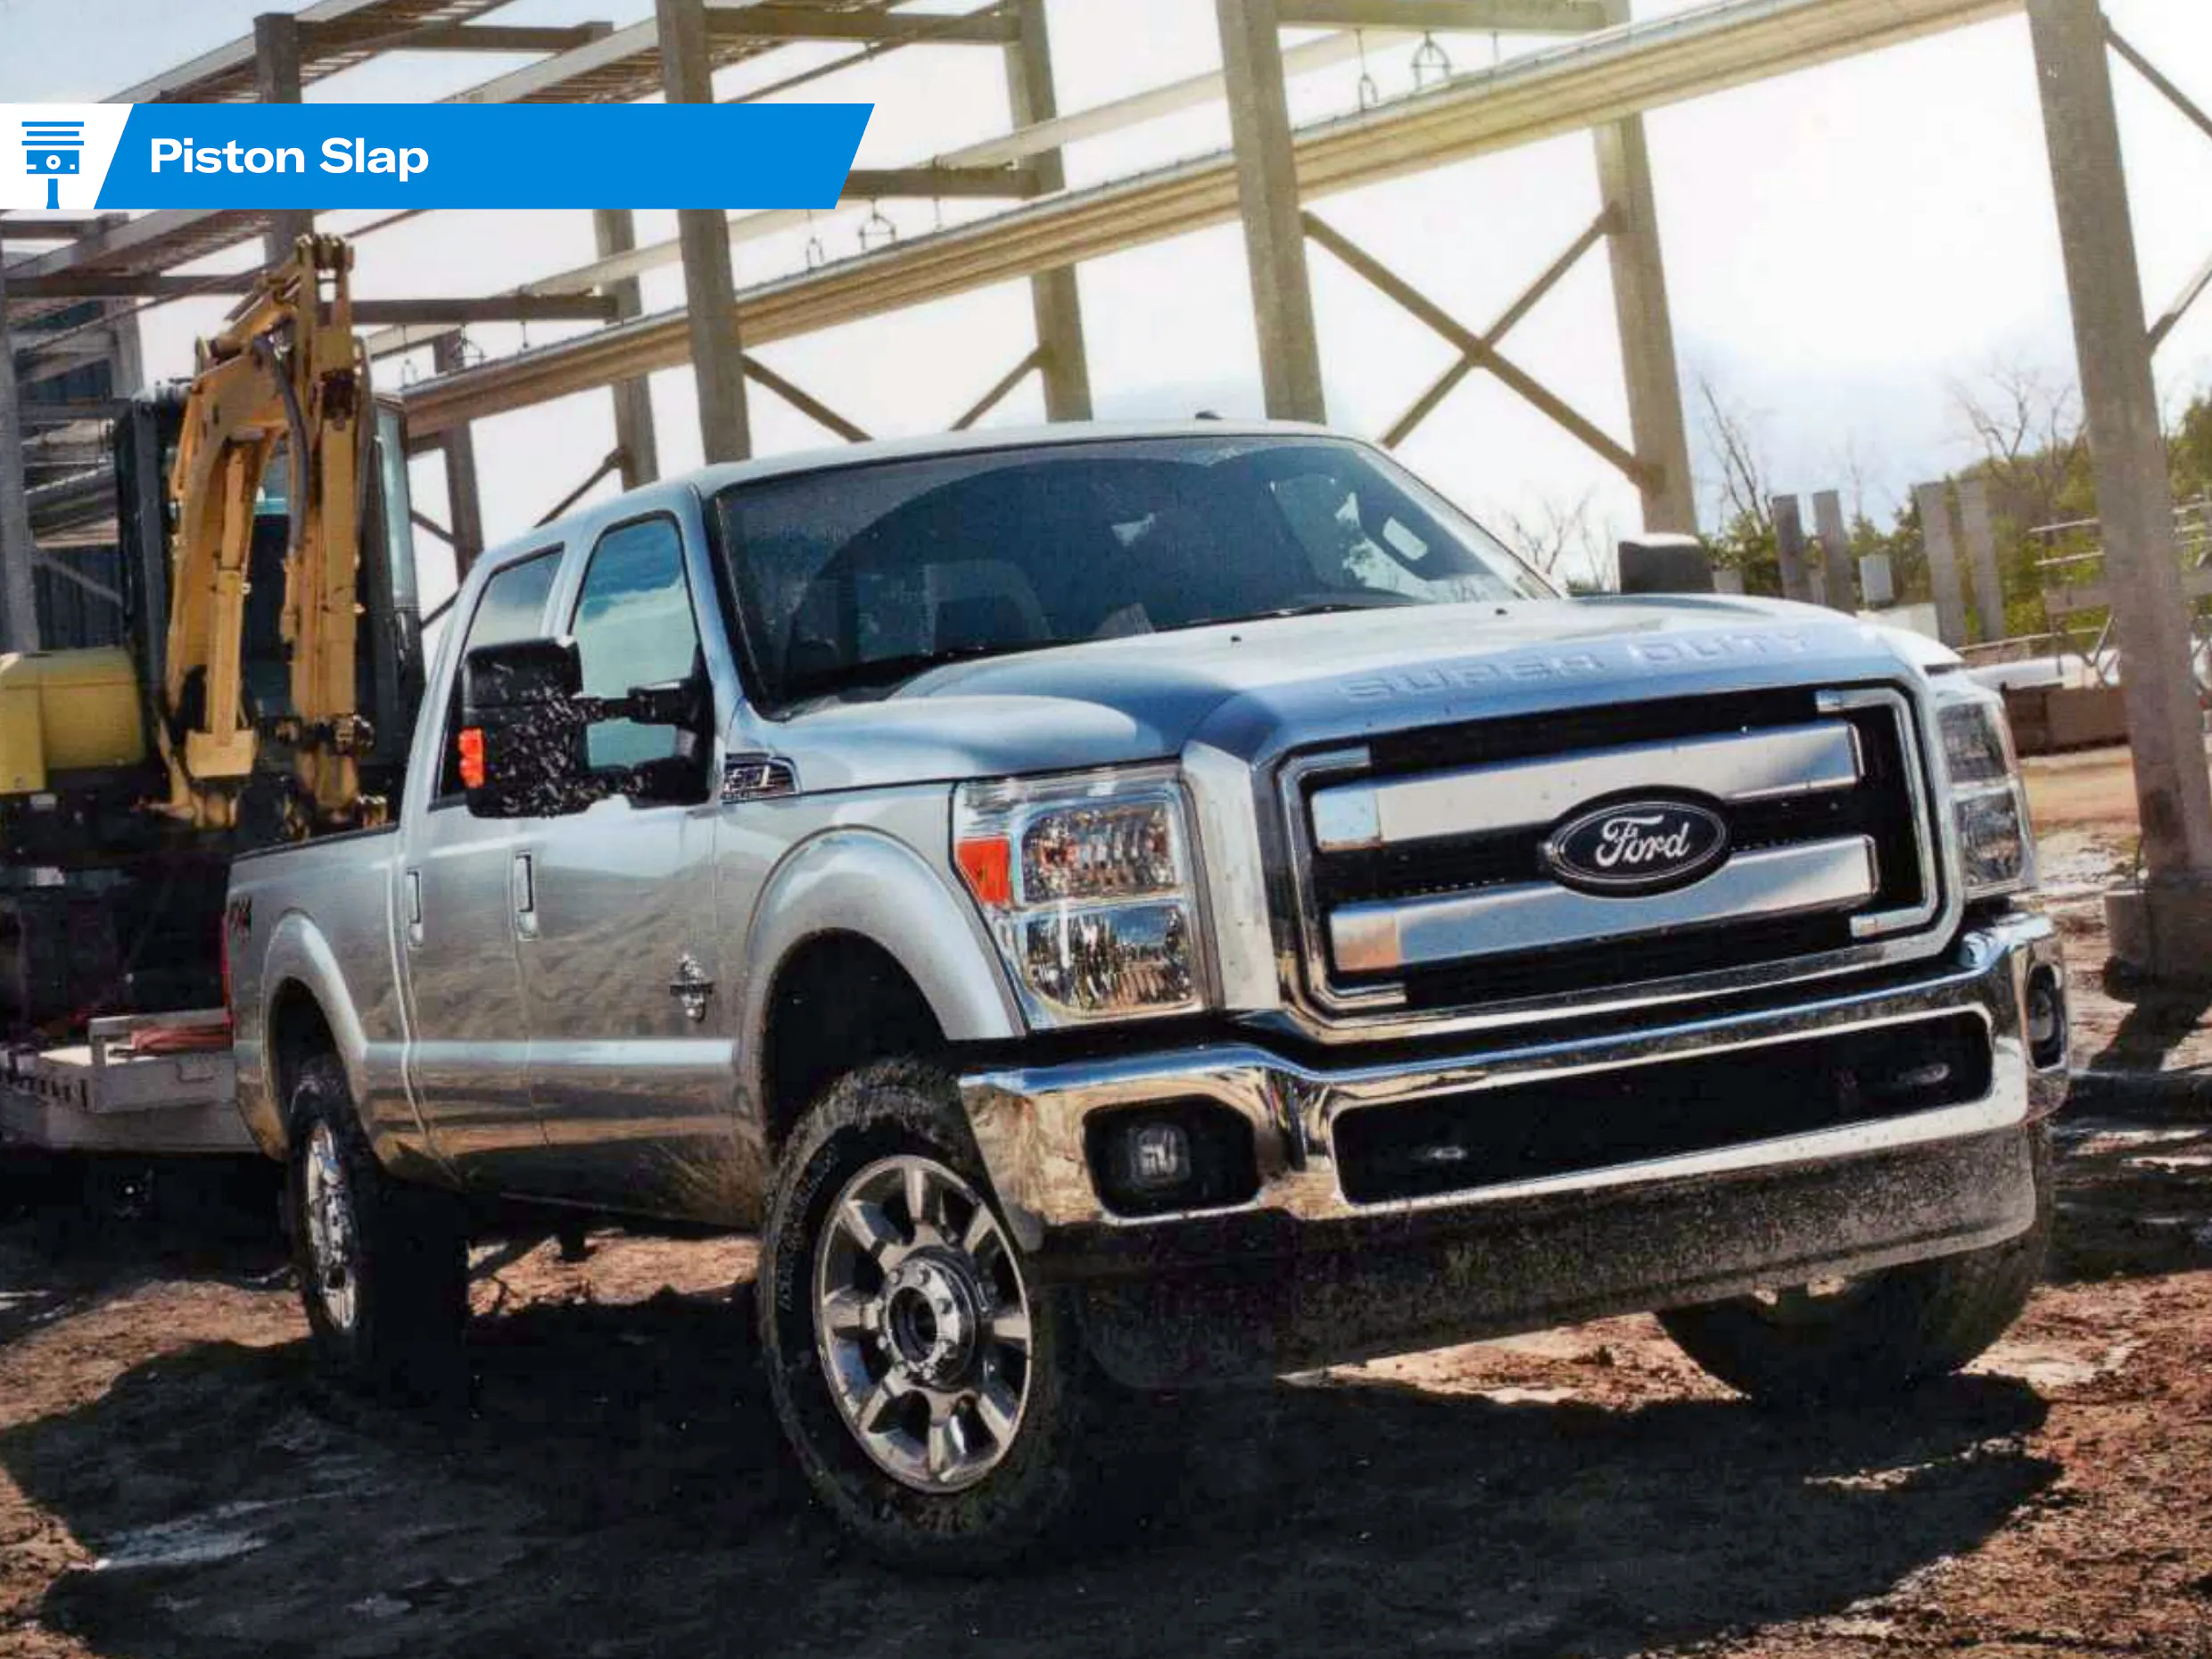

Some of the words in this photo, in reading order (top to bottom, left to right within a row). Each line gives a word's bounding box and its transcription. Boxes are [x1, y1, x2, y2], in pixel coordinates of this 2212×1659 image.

[1341, 655, 1604, 701] SUPER
[1627, 629, 1811, 673] DUTY
[1595, 815, 1689, 866] Ford
